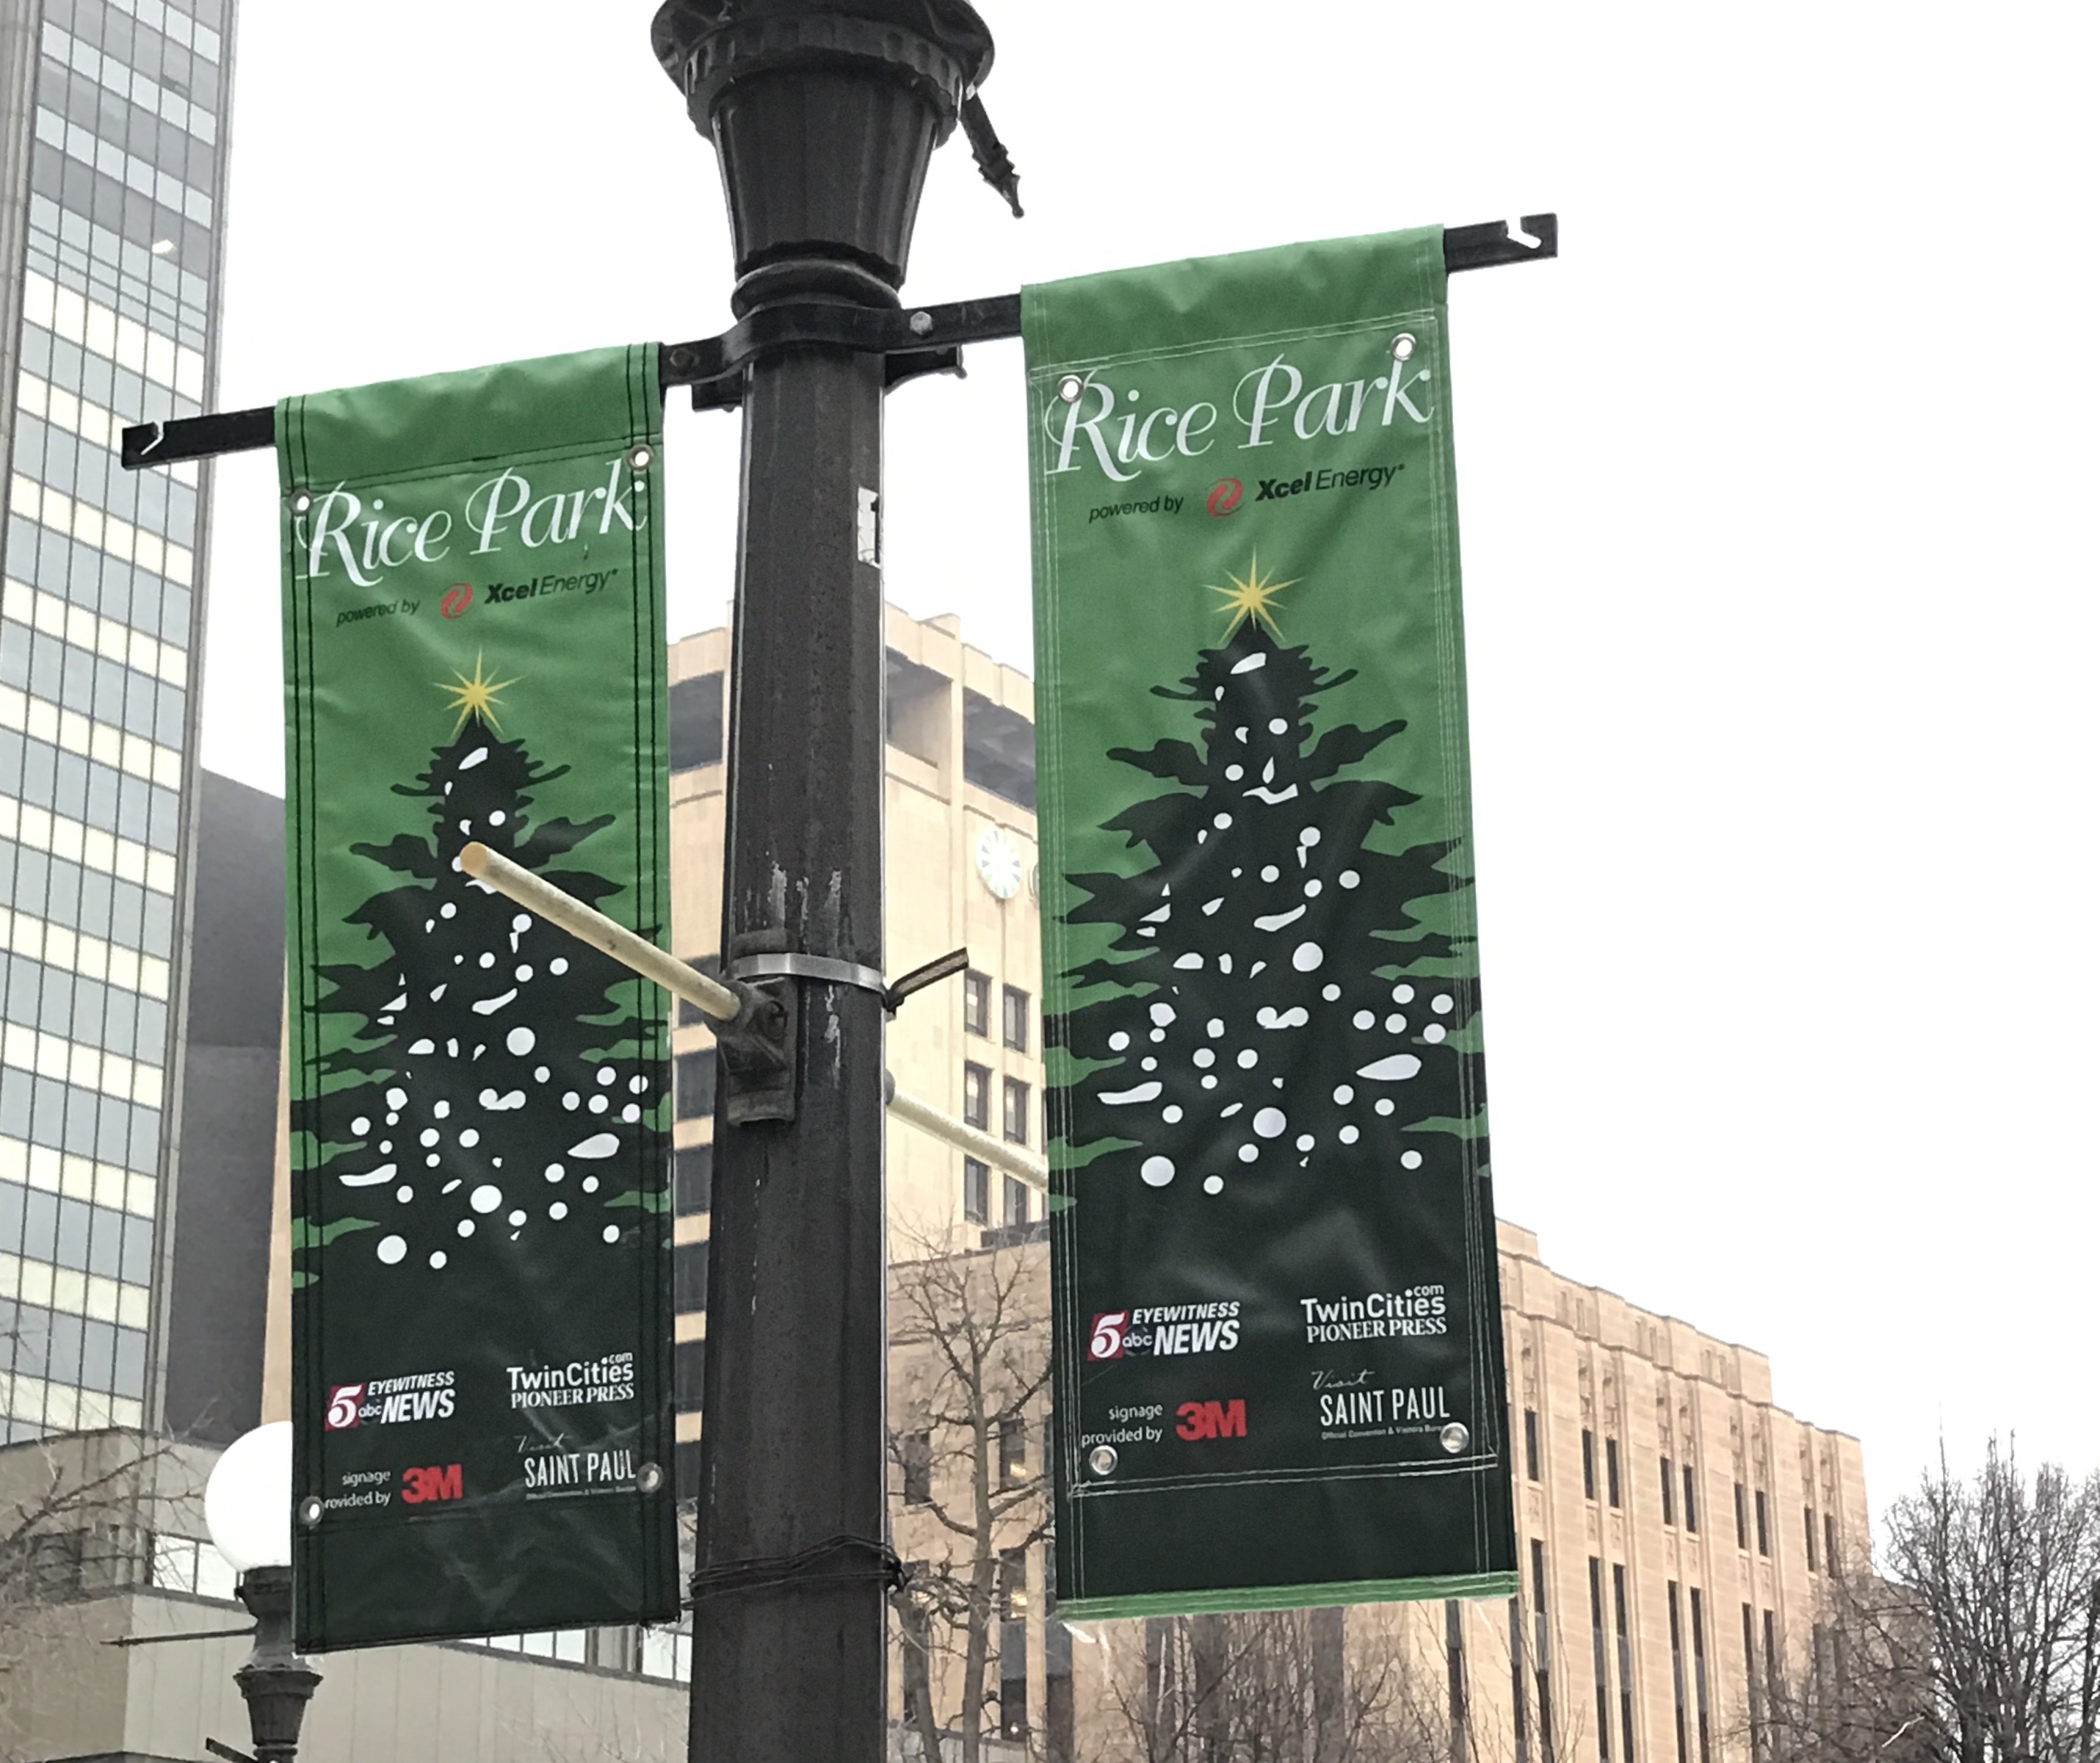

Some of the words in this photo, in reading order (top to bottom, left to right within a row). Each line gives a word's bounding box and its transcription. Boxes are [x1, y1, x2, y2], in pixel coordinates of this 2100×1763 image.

[1045, 369, 1217, 482] Rice
[1232, 353, 1435, 449] Park
[295, 480, 452, 587] Rice
[465, 457, 648, 556] Park
[1088, 498, 1160, 524] powered
[1164, 494, 1184, 514] by
[336, 602, 397, 627] powered
[400, 598, 421, 615] by
[1132, 1301, 1241, 1325] EYEWITNESS
[1090, 1312, 1125, 1358] 5
[1122, 1332, 1153, 1347] abc
[1154, 1319, 1240, 1355] NEWS
[1307, 1320, 1386, 1343] PIONEER
[1388, 1317, 1447, 1336] PRESS
[368, 1371, 455, 1396] EYEWITNESS
[511, 1387, 584, 1409] PIONEER
[586, 1383, 634, 1403] PRESS
[327, 1385, 363, 1428] 5
[358, 1402, 382, 1418] abc
[380, 1389, 456, 1424] NEWS
[1108, 1404, 1163, 1423] signage
[1176, 1399, 1247, 1441] 3M
[1321, 1390, 1385, 1426] SAINT
[1392, 1386, 1451, 1421] PAUL
[1081, 1427, 1143, 1448] provided
[1145, 1426, 1163, 1443] by
[341, 1471, 391, 1488] signage
[524, 1453, 581, 1488] SAINT
[587, 1449, 637, 1483] PAUL
[401, 1464, 463, 1503] 3M
[325, 1491, 374, 1509] rovided
[374, 1491, 391, 1506] by
